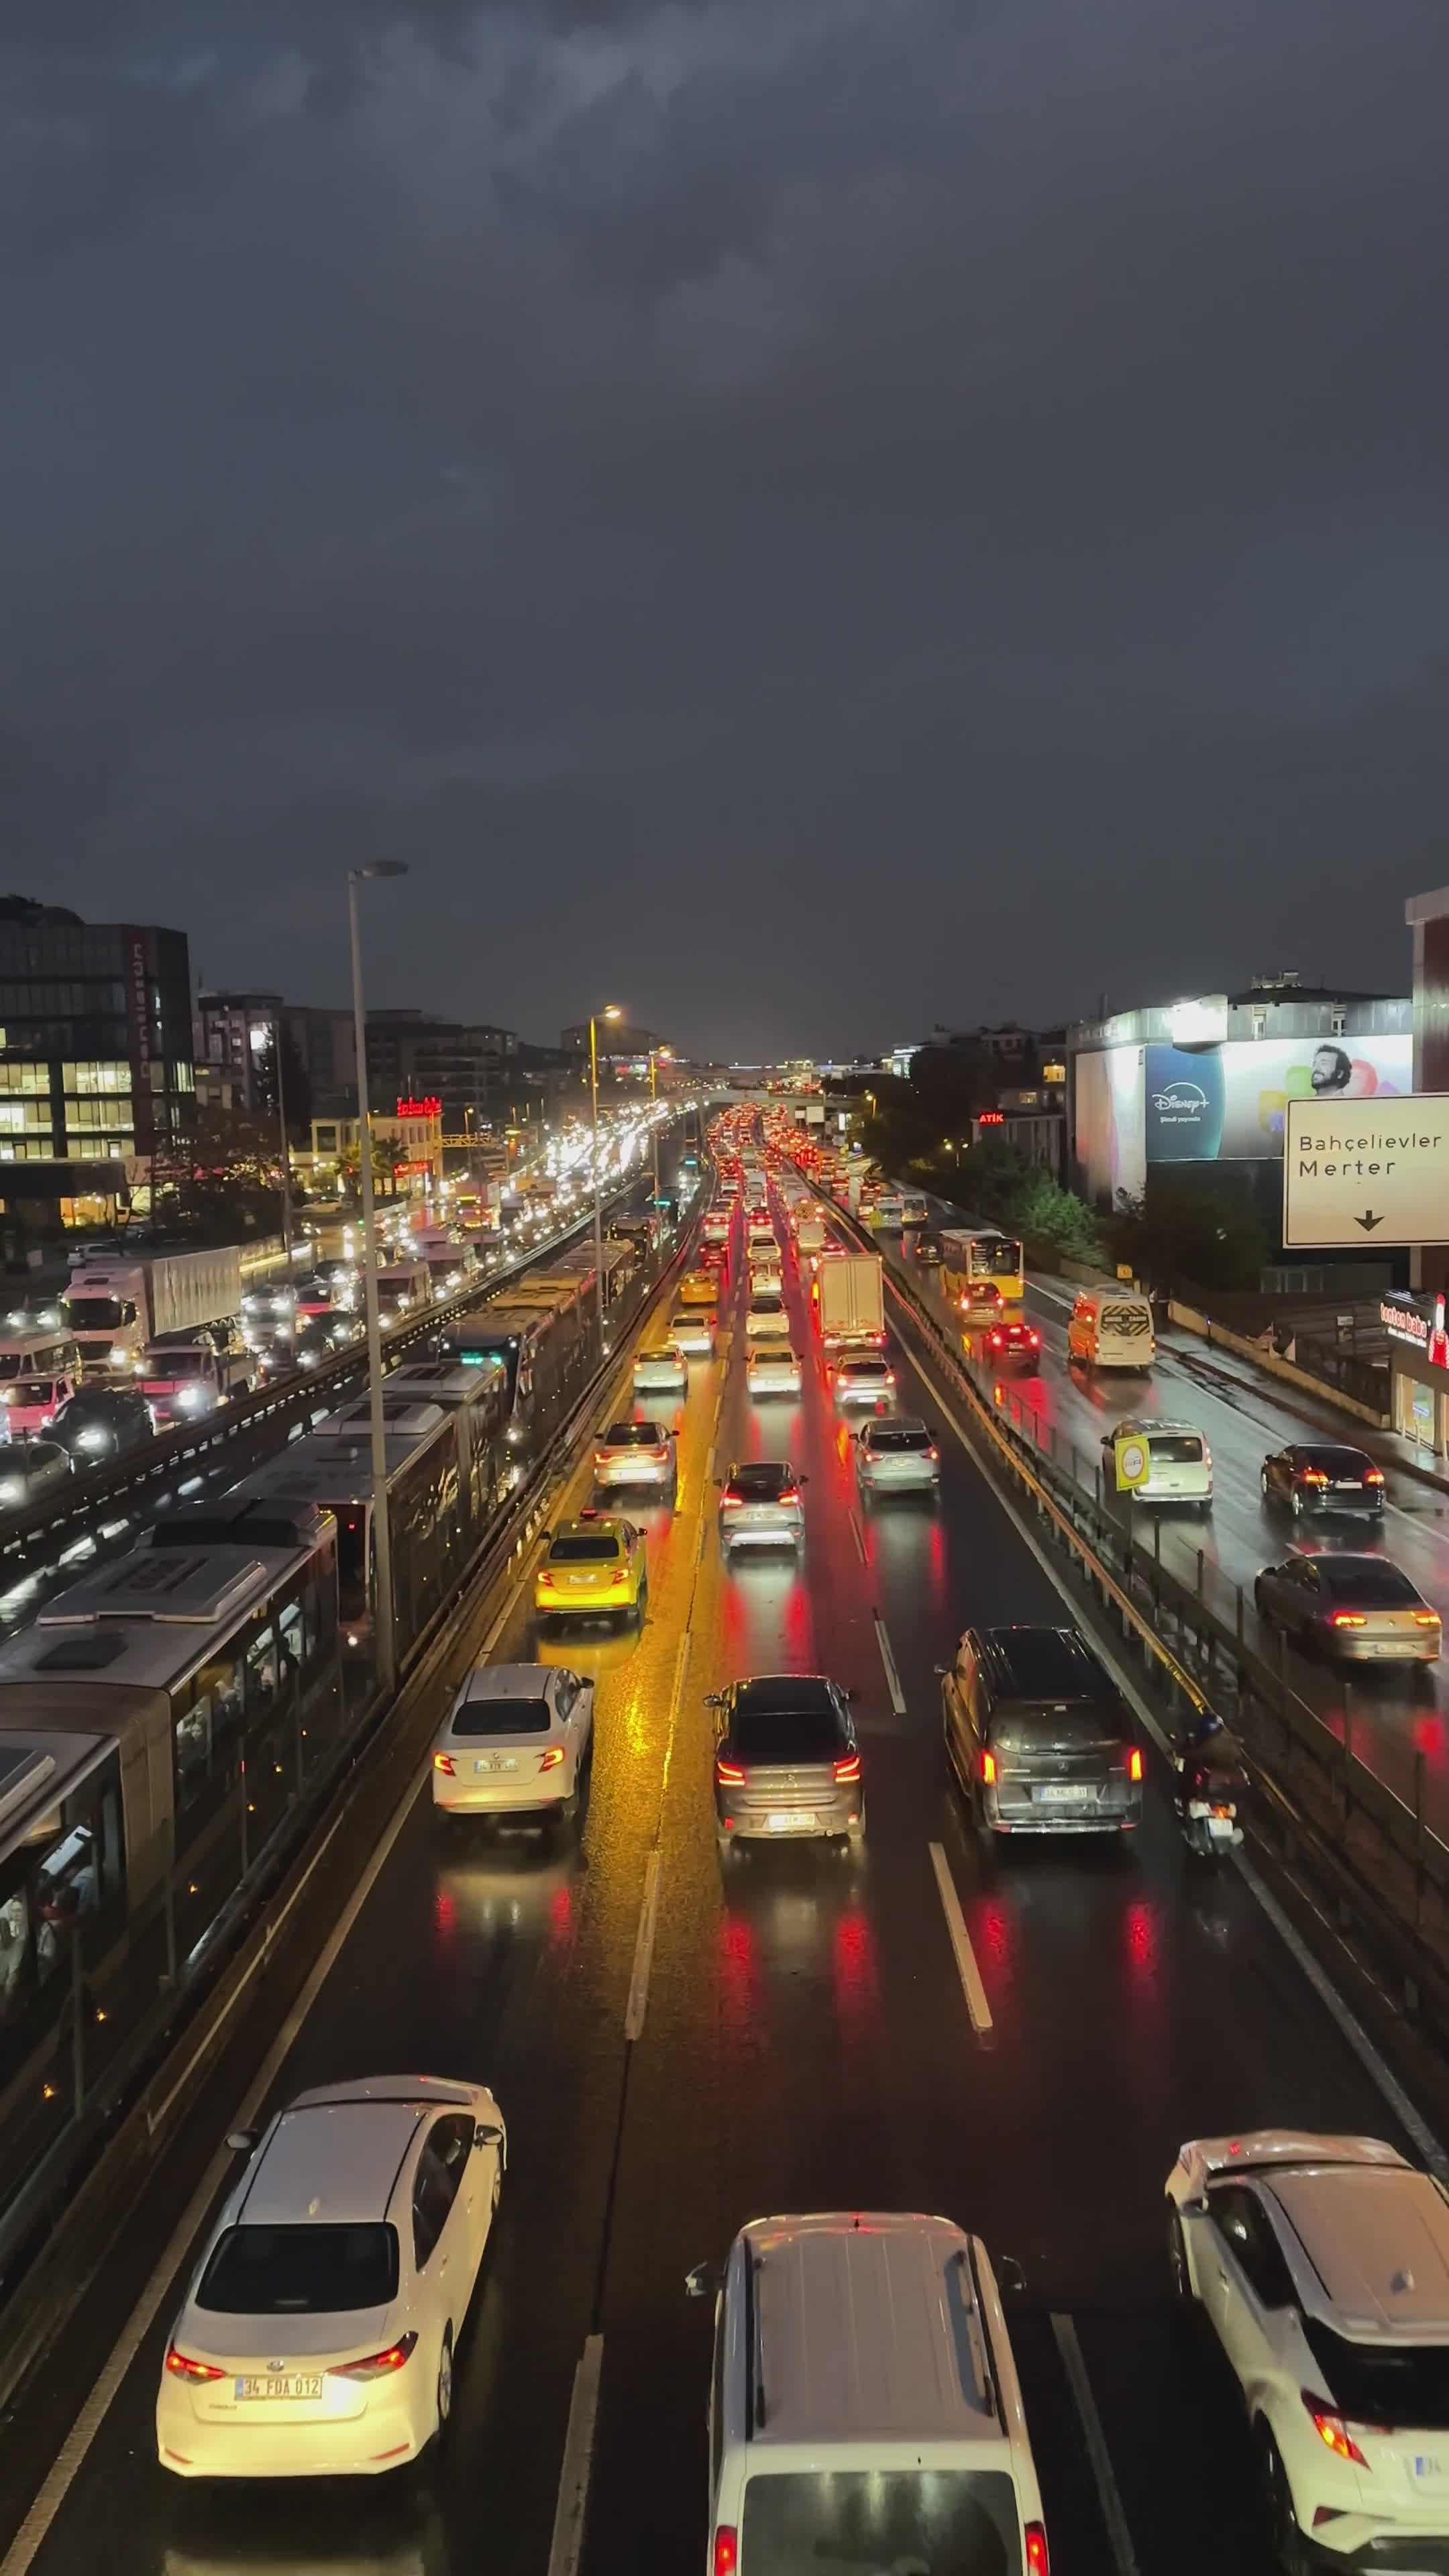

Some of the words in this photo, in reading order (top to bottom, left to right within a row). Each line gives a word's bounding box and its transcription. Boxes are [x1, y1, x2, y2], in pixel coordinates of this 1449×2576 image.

[1299, 1133, 1442, 1152] Bahçelievler
[1299, 1160, 1396, 1177] Merter
[1406, 1311, 1428, 1339] baba
[245, 2377, 260, 2395] 34
[295, 2376, 319, 2395] 012
